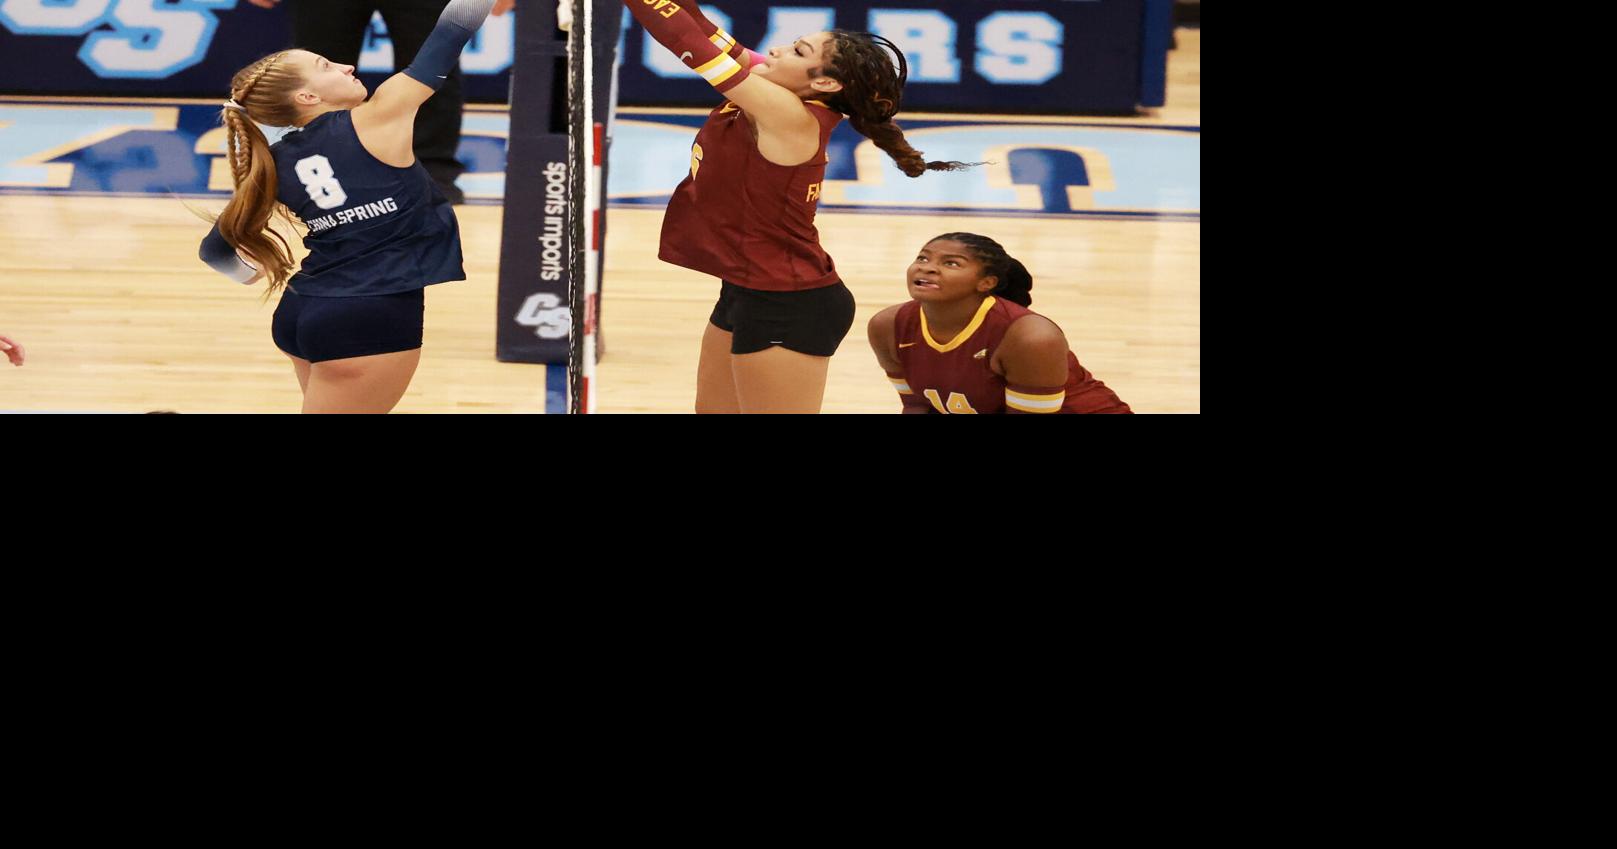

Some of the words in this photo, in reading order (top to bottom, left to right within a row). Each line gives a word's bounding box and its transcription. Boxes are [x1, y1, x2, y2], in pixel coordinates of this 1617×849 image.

[294, 154, 348, 210] 8
[541, 161, 567, 215] sports
[335, 197, 399, 225] SPRING
[538, 216, 564, 281] imports
[923, 388, 979, 415] 14
